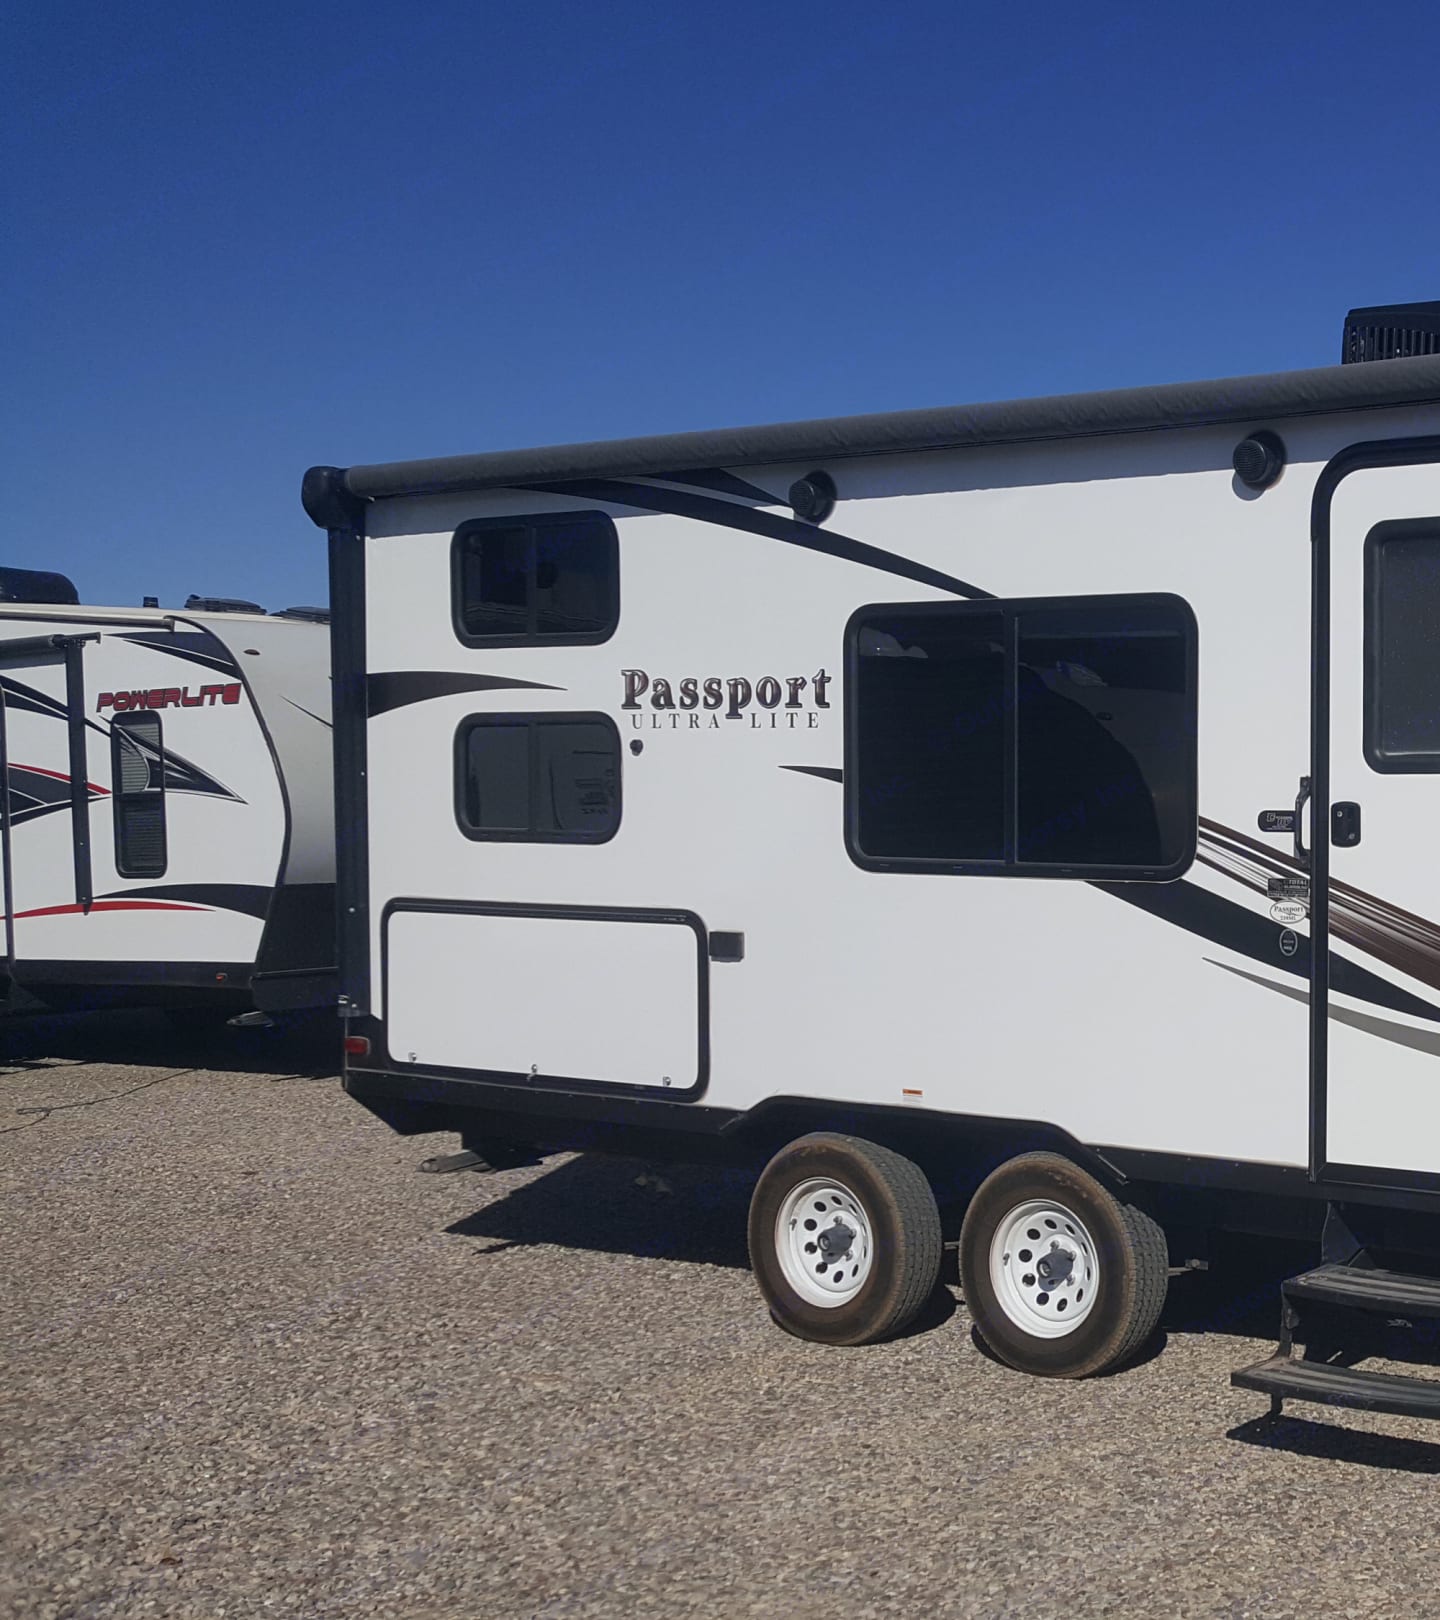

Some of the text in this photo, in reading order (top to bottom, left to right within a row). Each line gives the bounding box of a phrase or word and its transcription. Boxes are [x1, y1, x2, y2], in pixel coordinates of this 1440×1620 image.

[96, 682, 242, 713] POWERLITE
[620, 668, 832, 719] Passport
[631, 712, 819, 729] ULTRA LITE
